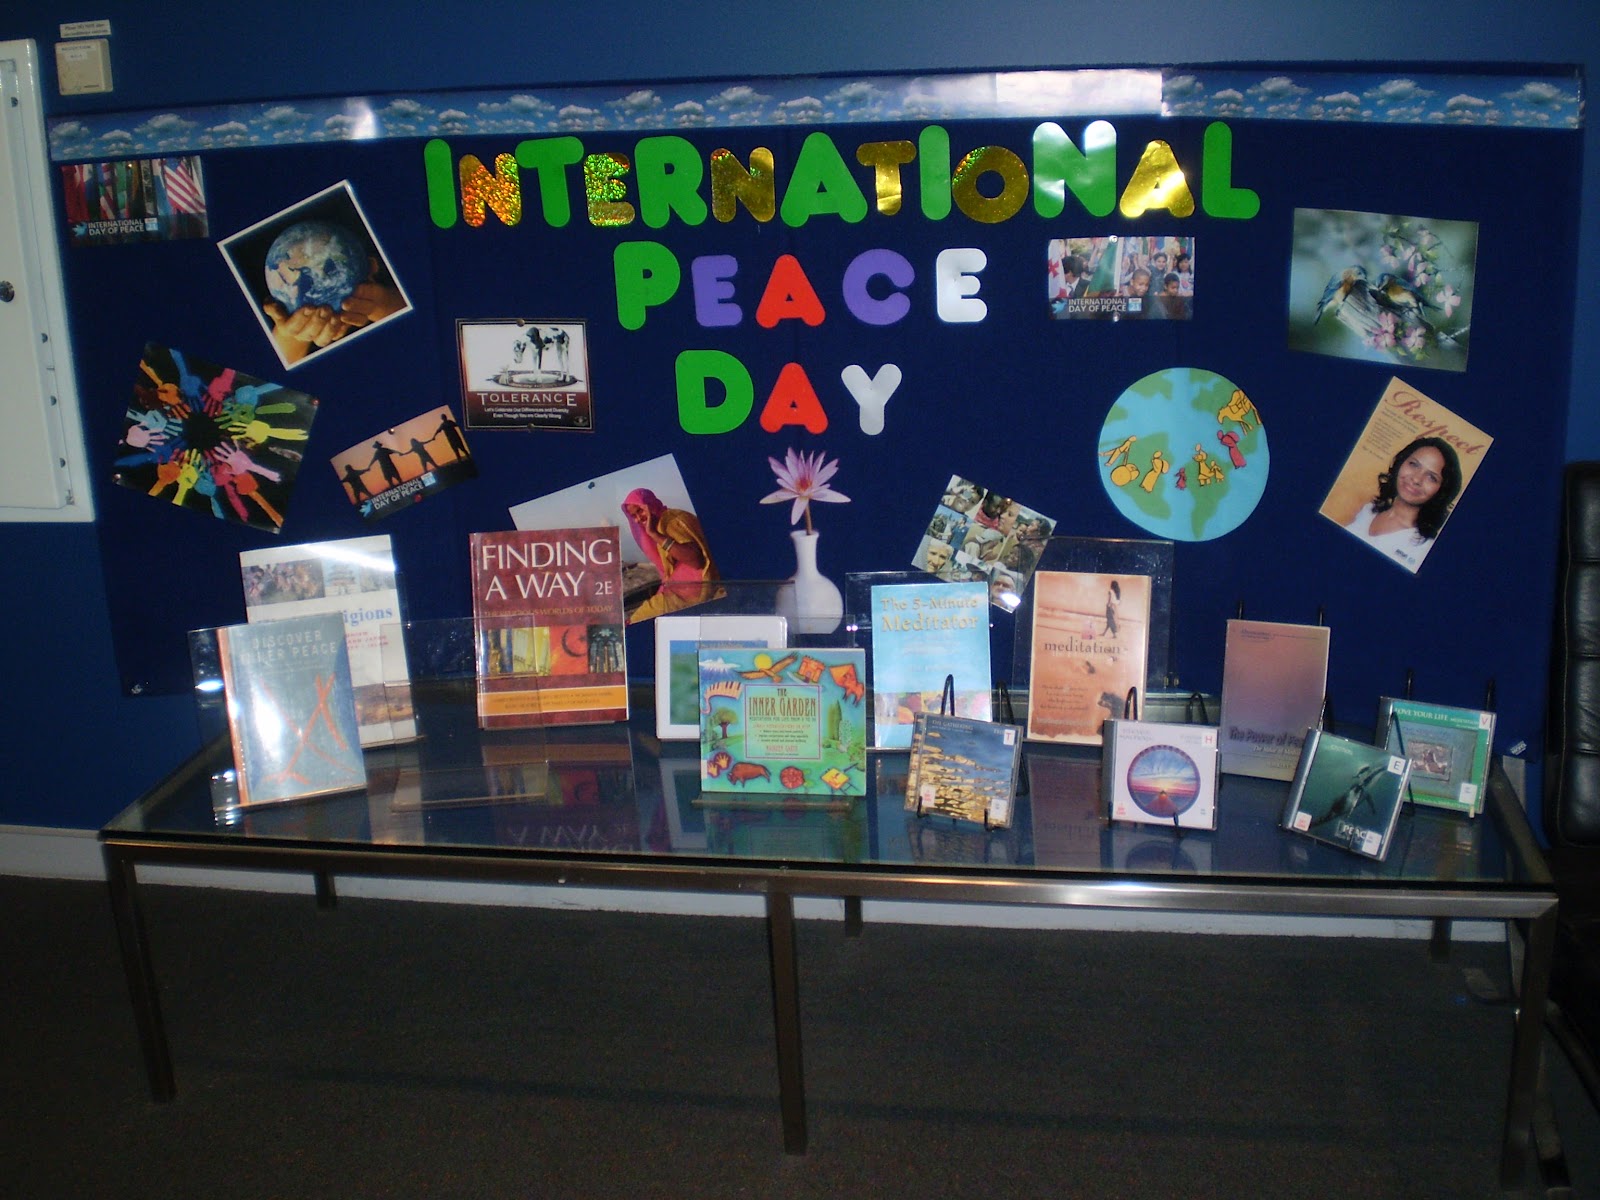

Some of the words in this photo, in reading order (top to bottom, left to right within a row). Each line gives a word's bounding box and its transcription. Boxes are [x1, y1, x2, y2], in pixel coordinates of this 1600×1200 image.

[424, 120, 1260, 228] INTERNATIONAL
[88, 219, 144, 229] INTERNATIONAL
[89, 228, 106, 236] DAY
[120, 225, 144, 233] PEACE
[613, 240, 988, 330] PEACE
[1101, 304, 1127, 312] PEACE
[477, 392, 577, 406] TOLERANCE
[675, 349, 902, 435] DAY
[1385, 391, 1484, 455] Respect
[371, 478, 420, 504] INTERNATIONAL
[374, 499, 389, 510] DAY
[391, 493, 401, 502] OF
[401, 483, 424, 497] PEACE
[482, 539, 613, 570] FINDING
[485, 575, 507, 601] A
[515, 571, 585, 599] WAY
[595, 581, 613, 596] 2E
[540, 607, 573, 615] WORLDS
[586, 605, 613, 613] TODAY
[881, 598, 907, 611] The
[912, 596, 978, 611] 5-Minute
[340, 607, 393, 626] igions
[882, 612, 979, 632] Meditator
[252, 630, 321, 649] DISCOVER
[1044, 636, 1121, 655] meditation
[292, 642, 337, 657] PEACE
[777, 688, 787, 697] THE
[749, 697, 776, 716] INNER
[780, 697, 816, 717] GARDEN
[1394, 708, 1412, 716] LOVE
[1413, 709, 1433, 719] YOUR
[1205, 735, 1213, 743] H
[1246, 728, 1275, 744] Power
[1393, 761, 1401, 770] E
[1342, 823, 1368, 839] PEAC
